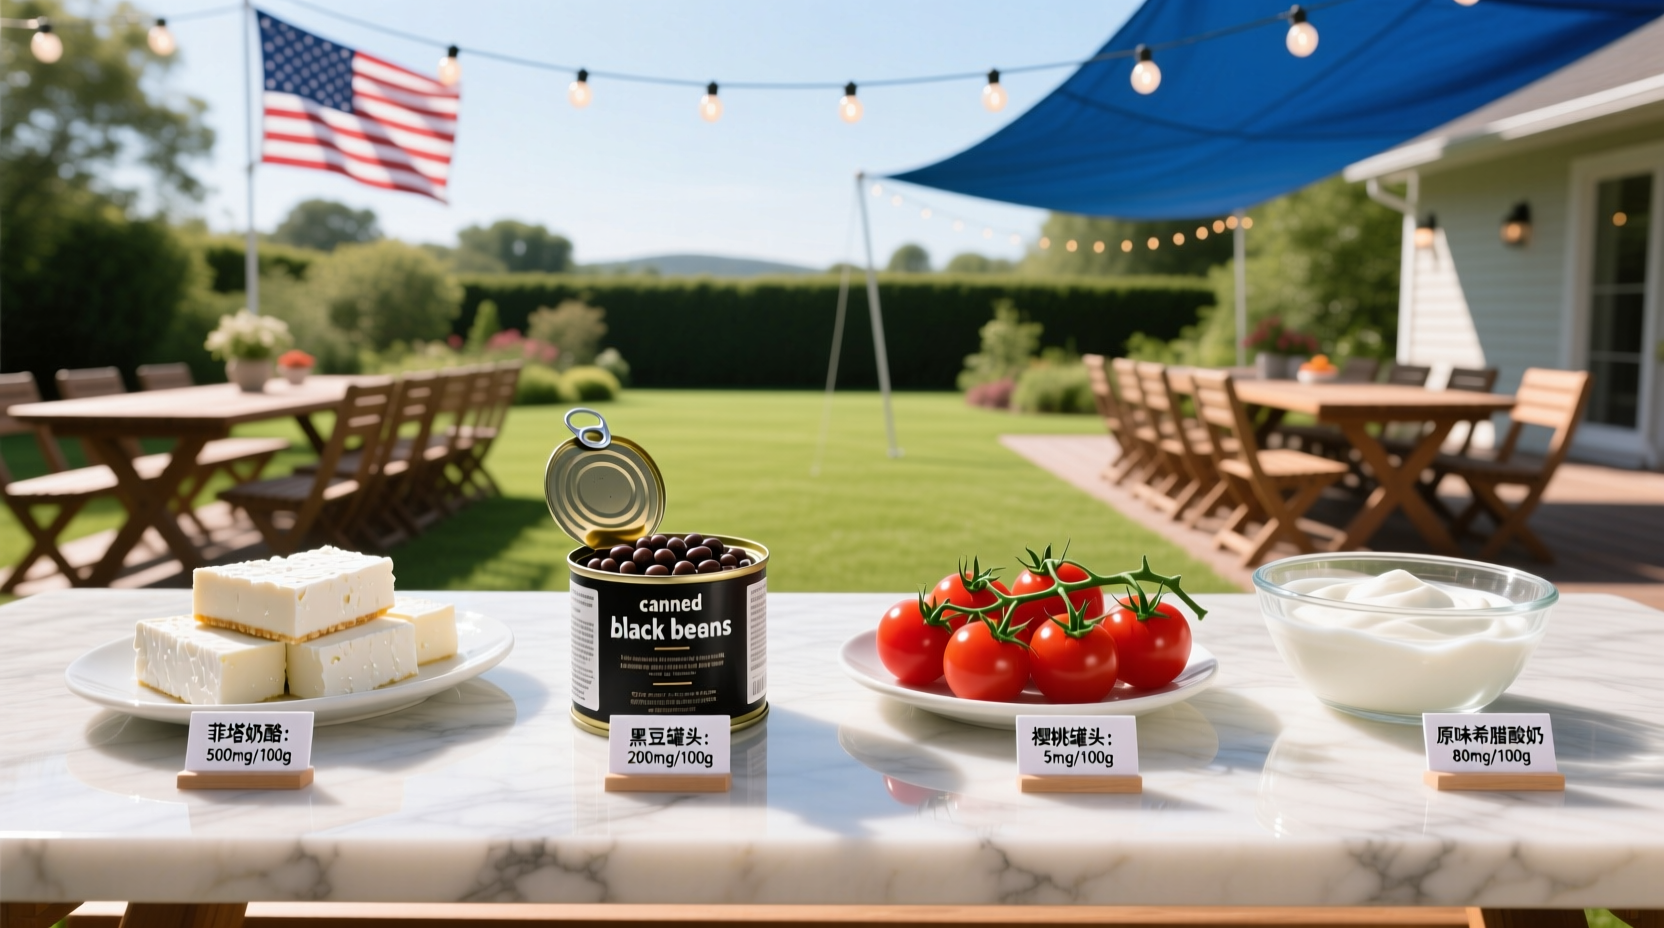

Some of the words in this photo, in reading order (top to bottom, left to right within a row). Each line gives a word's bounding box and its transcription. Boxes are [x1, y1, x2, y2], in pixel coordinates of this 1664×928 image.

[639, 593, 702, 612] canned
[610, 616, 665, 640] black
[1436, 724, 1544, 745] 原味希腊酸奶
[206, 747, 292, 766] 500mg/100g
[627, 750, 714, 768] 200mg/100g
[1043, 750, 1114, 768] 5mg/100g
[1452, 748, 1531, 766] 80mg/100g
